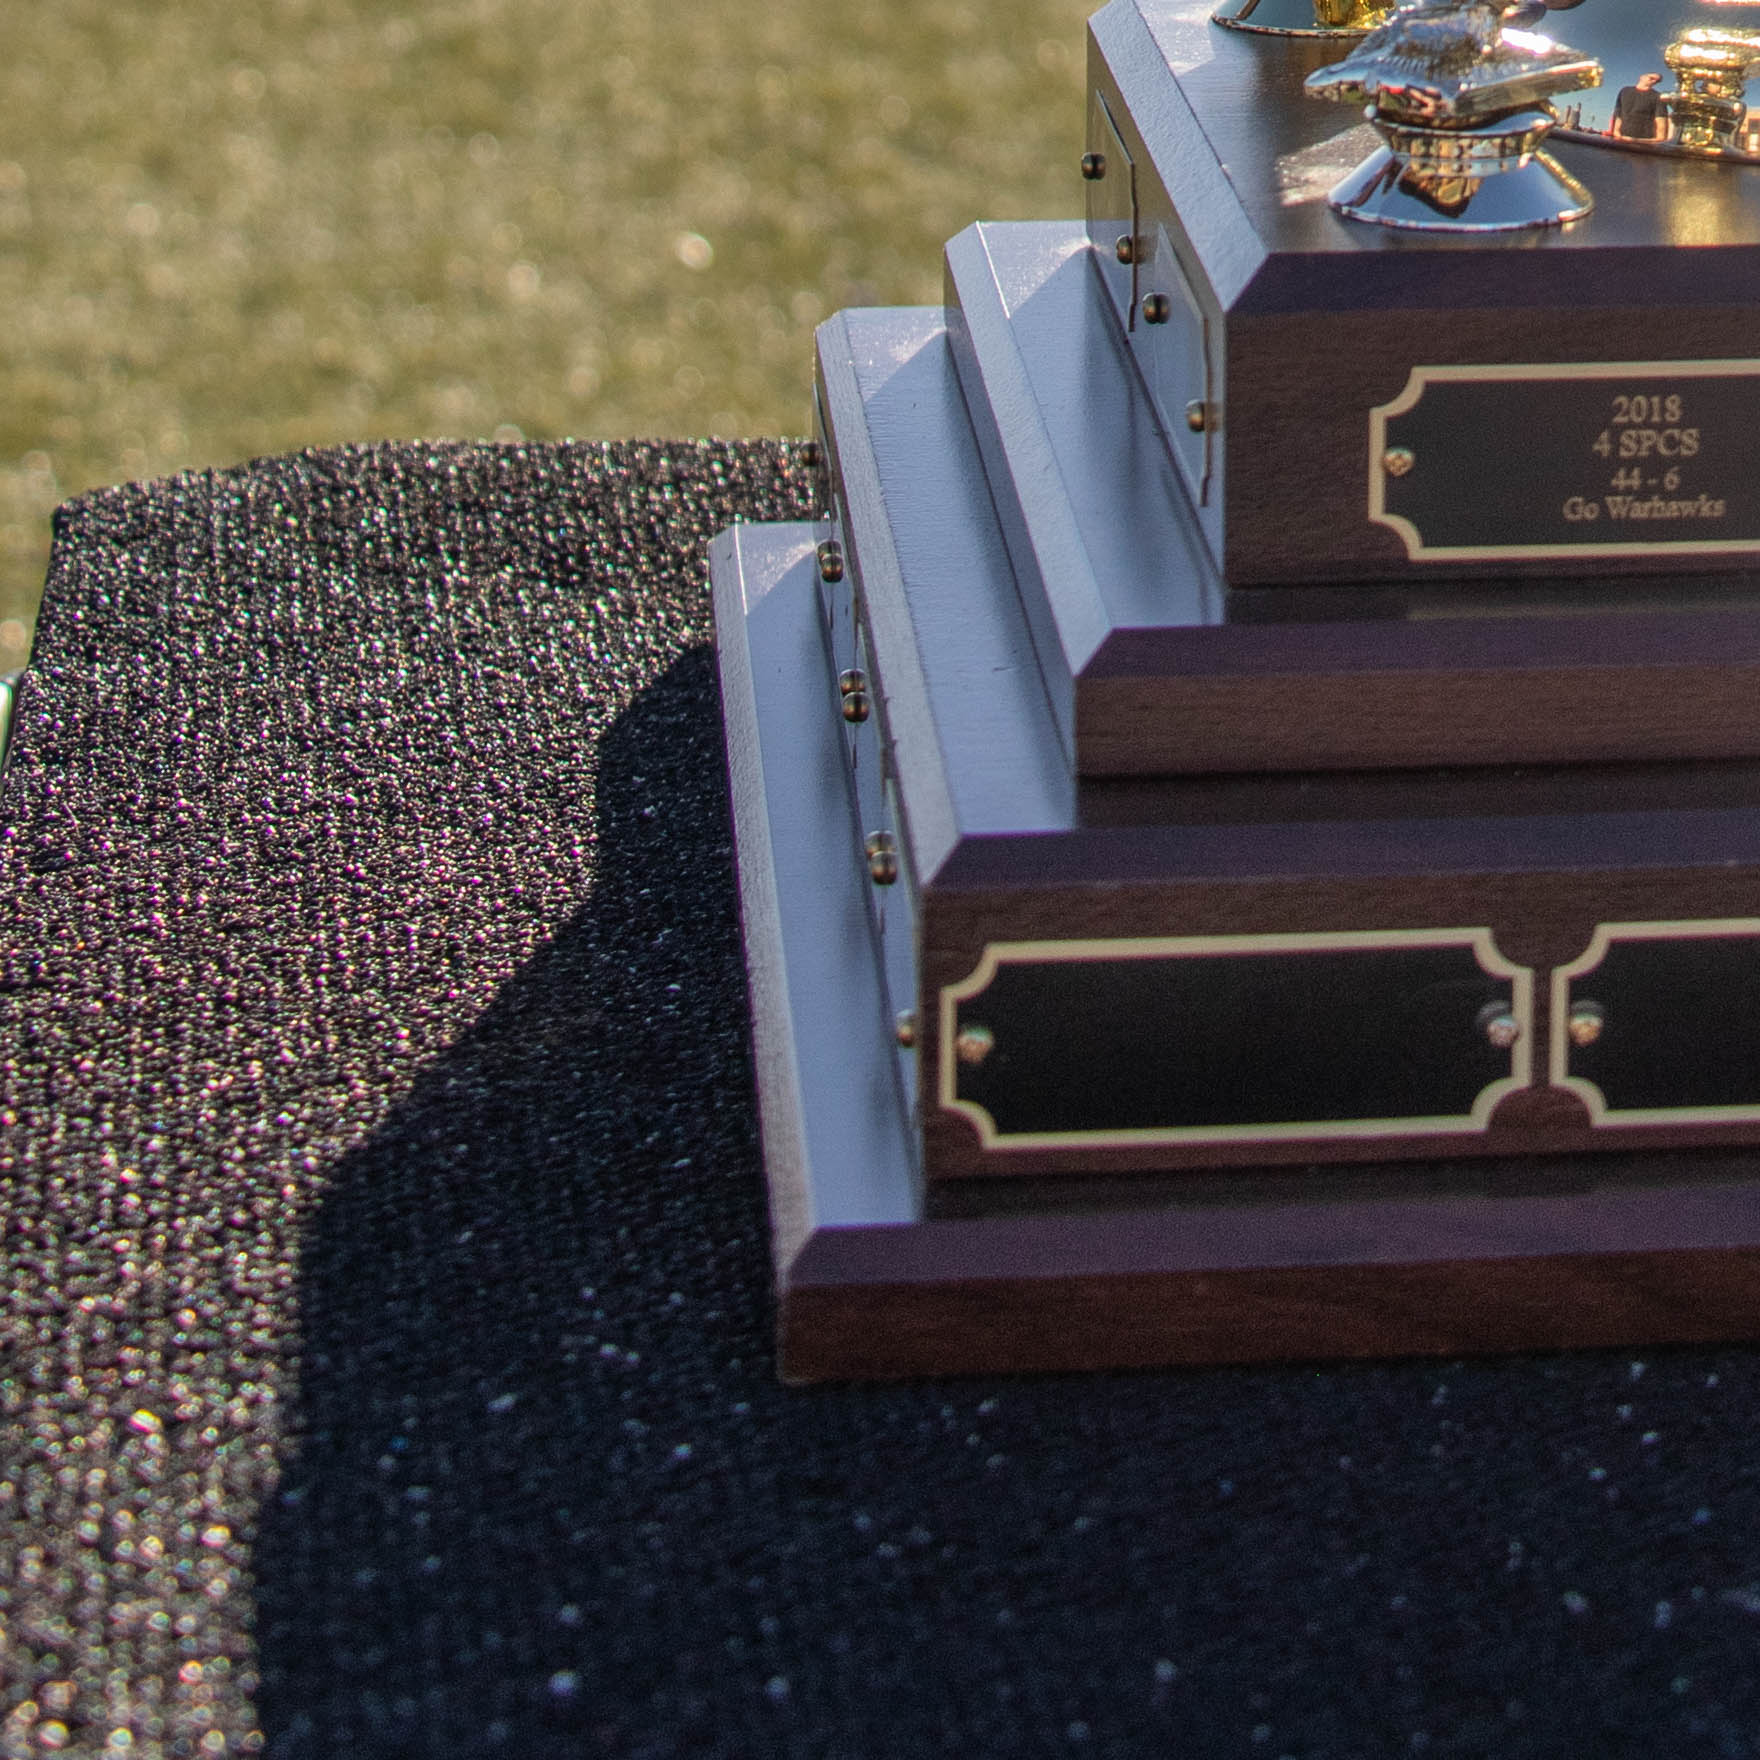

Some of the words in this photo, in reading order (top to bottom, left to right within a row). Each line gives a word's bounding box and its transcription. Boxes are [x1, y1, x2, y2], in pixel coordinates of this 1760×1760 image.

[1611, 394, 1683, 423] 2018
[1592, 429, 1612, 457] 4
[1618, 428, 1700, 458] SPCS
[1610, 467, 1642, 490] 44
[1663, 465, 1682, 491] 6
[1562, 495, 1600, 521] Go
